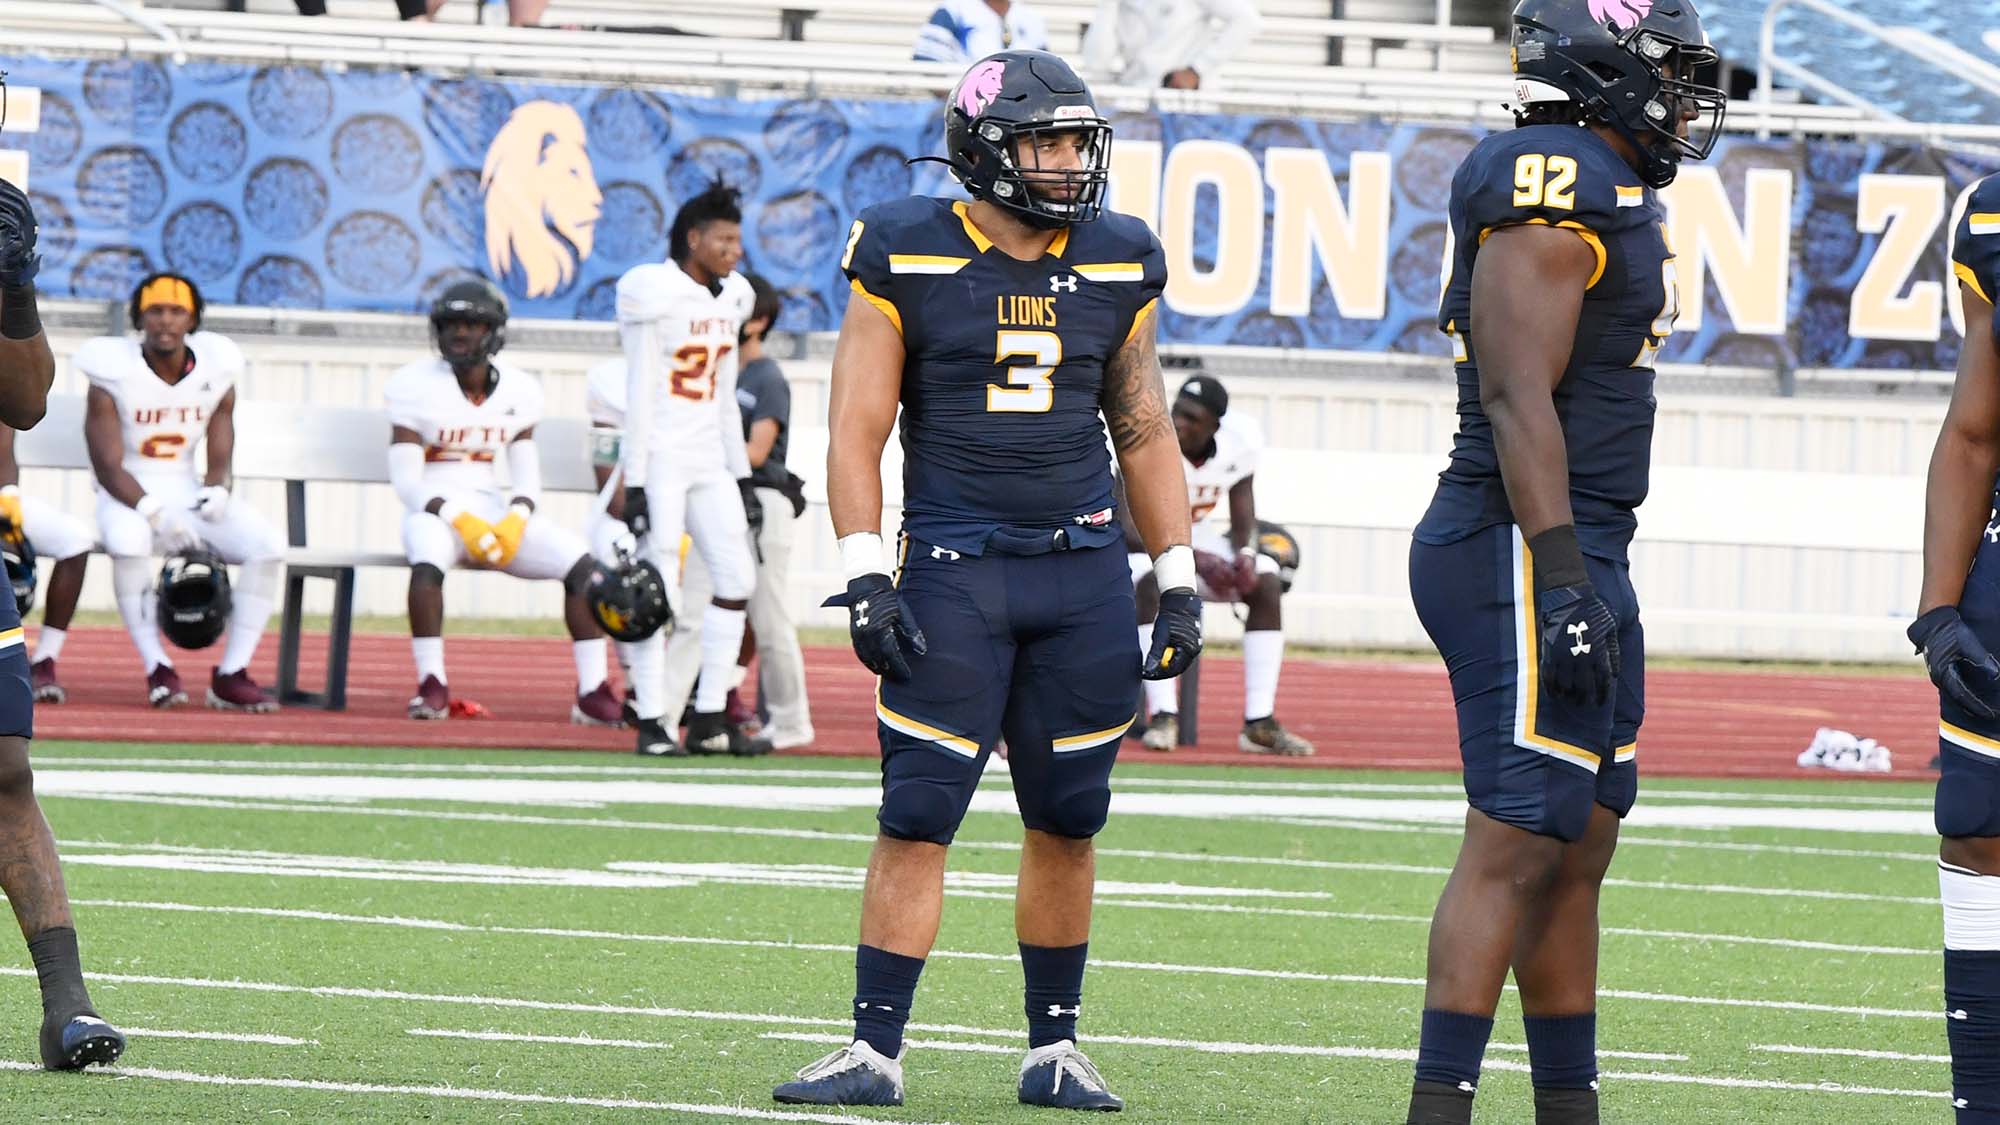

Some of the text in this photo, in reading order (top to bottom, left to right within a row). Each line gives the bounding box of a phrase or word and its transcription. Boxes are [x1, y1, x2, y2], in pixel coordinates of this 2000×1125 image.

[1513, 153, 1577, 211] 92
[997, 295, 1057, 327] LIONS
[986, 329, 1063, 413] 3
